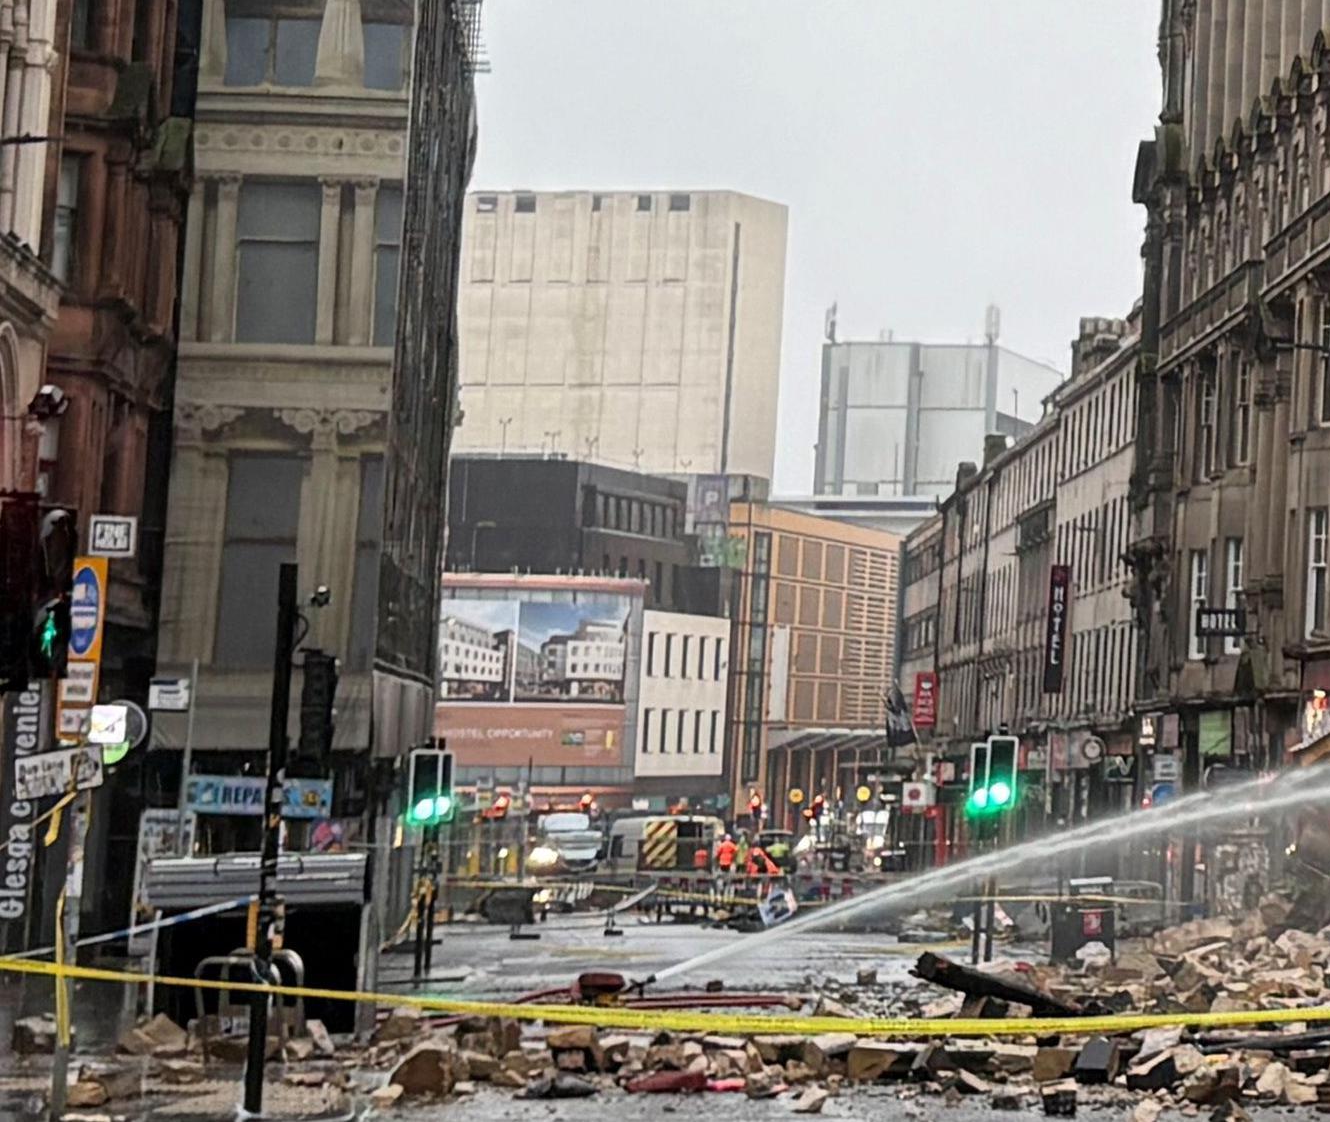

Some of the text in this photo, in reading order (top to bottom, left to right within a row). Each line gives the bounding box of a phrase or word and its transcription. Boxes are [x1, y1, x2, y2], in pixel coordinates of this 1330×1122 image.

[1051, 585, 1065, 665] HOTEL
[1202, 612, 1236, 629] HOTEL
[487, 728, 554, 740] OPPORTUNITY
